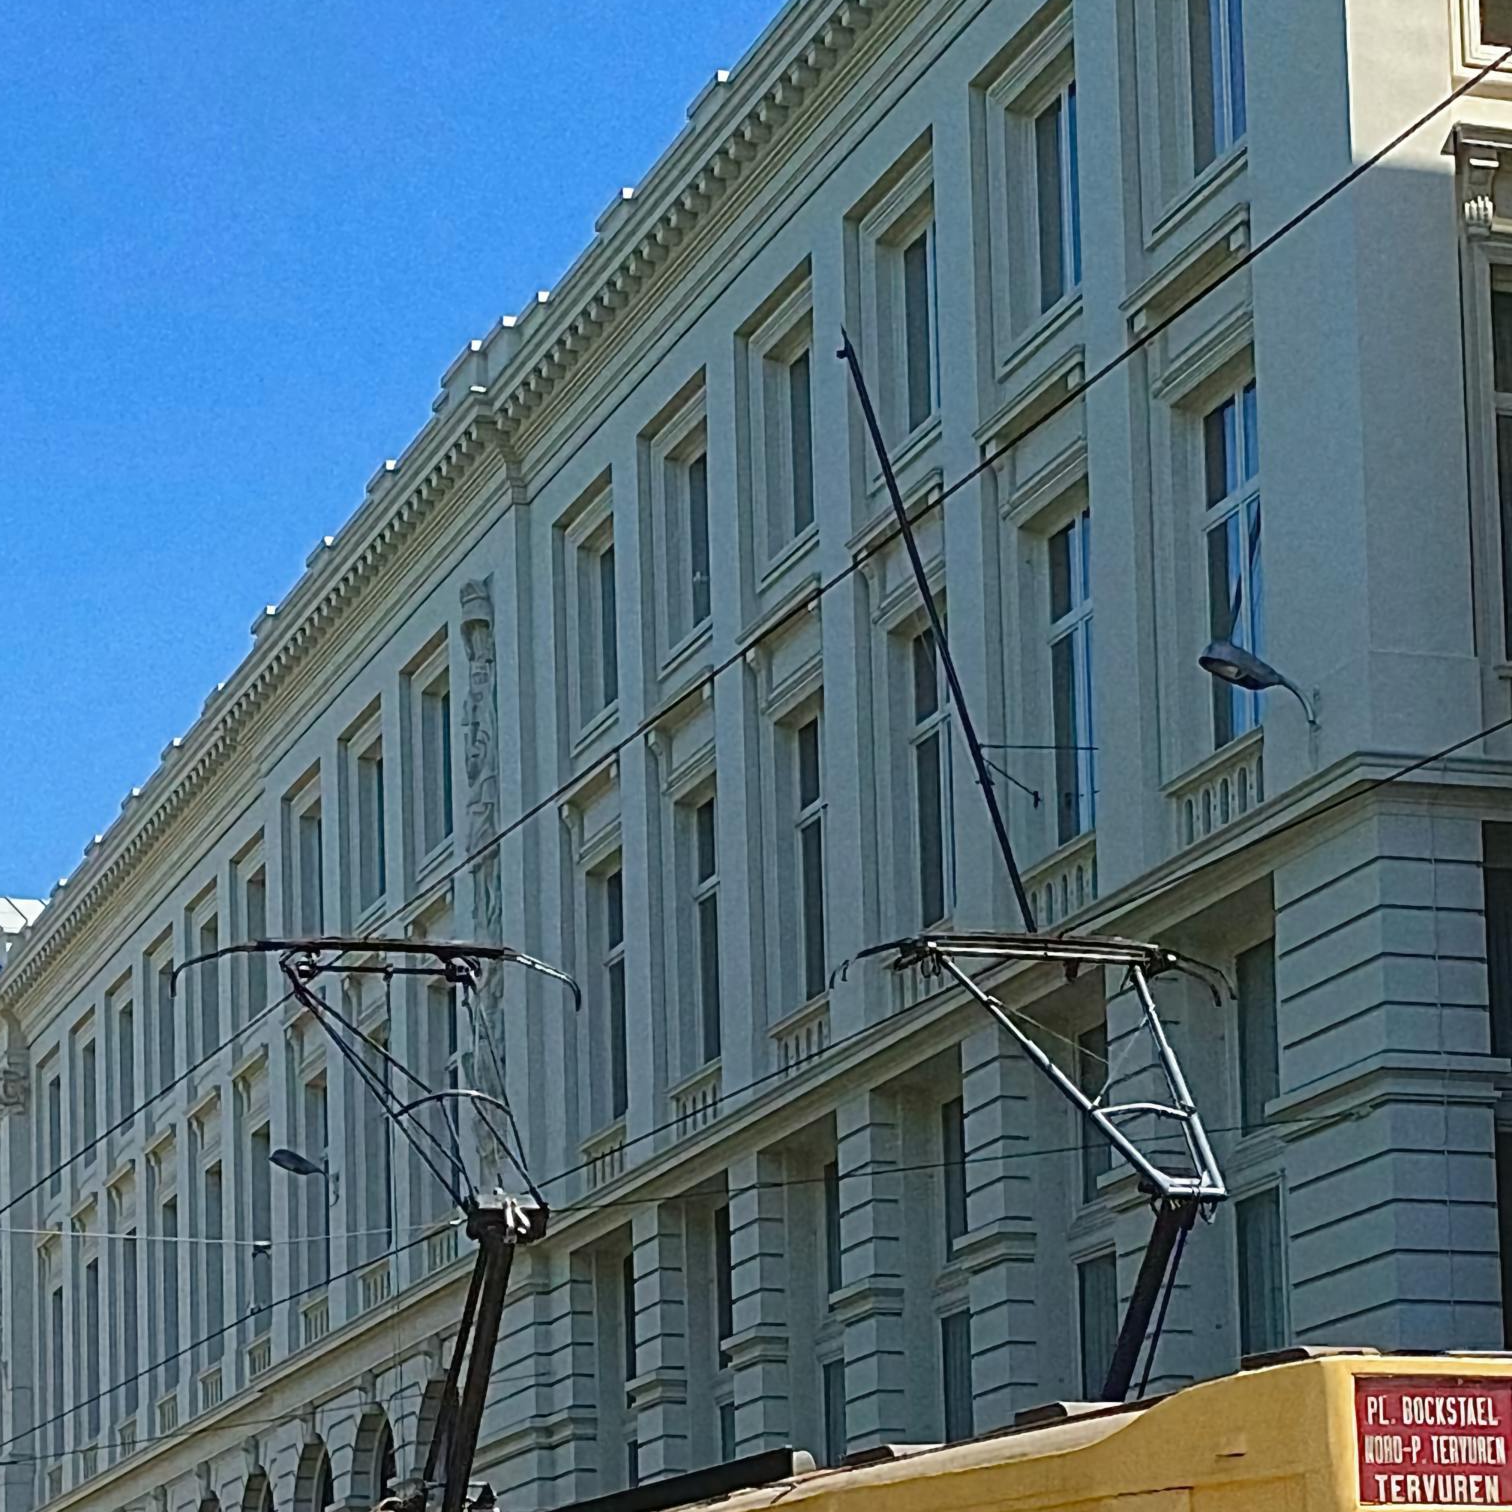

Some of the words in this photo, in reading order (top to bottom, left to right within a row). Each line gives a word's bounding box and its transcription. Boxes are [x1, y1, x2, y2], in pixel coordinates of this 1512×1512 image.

[1366, 1395, 1397, 1425] PL.
[1401, 1395, 1500, 1427] BOCKSTAEL
[1430, 1435, 1506, 1465] TERVUREN
[1374, 1473, 1501, 1503] TERVUREN
